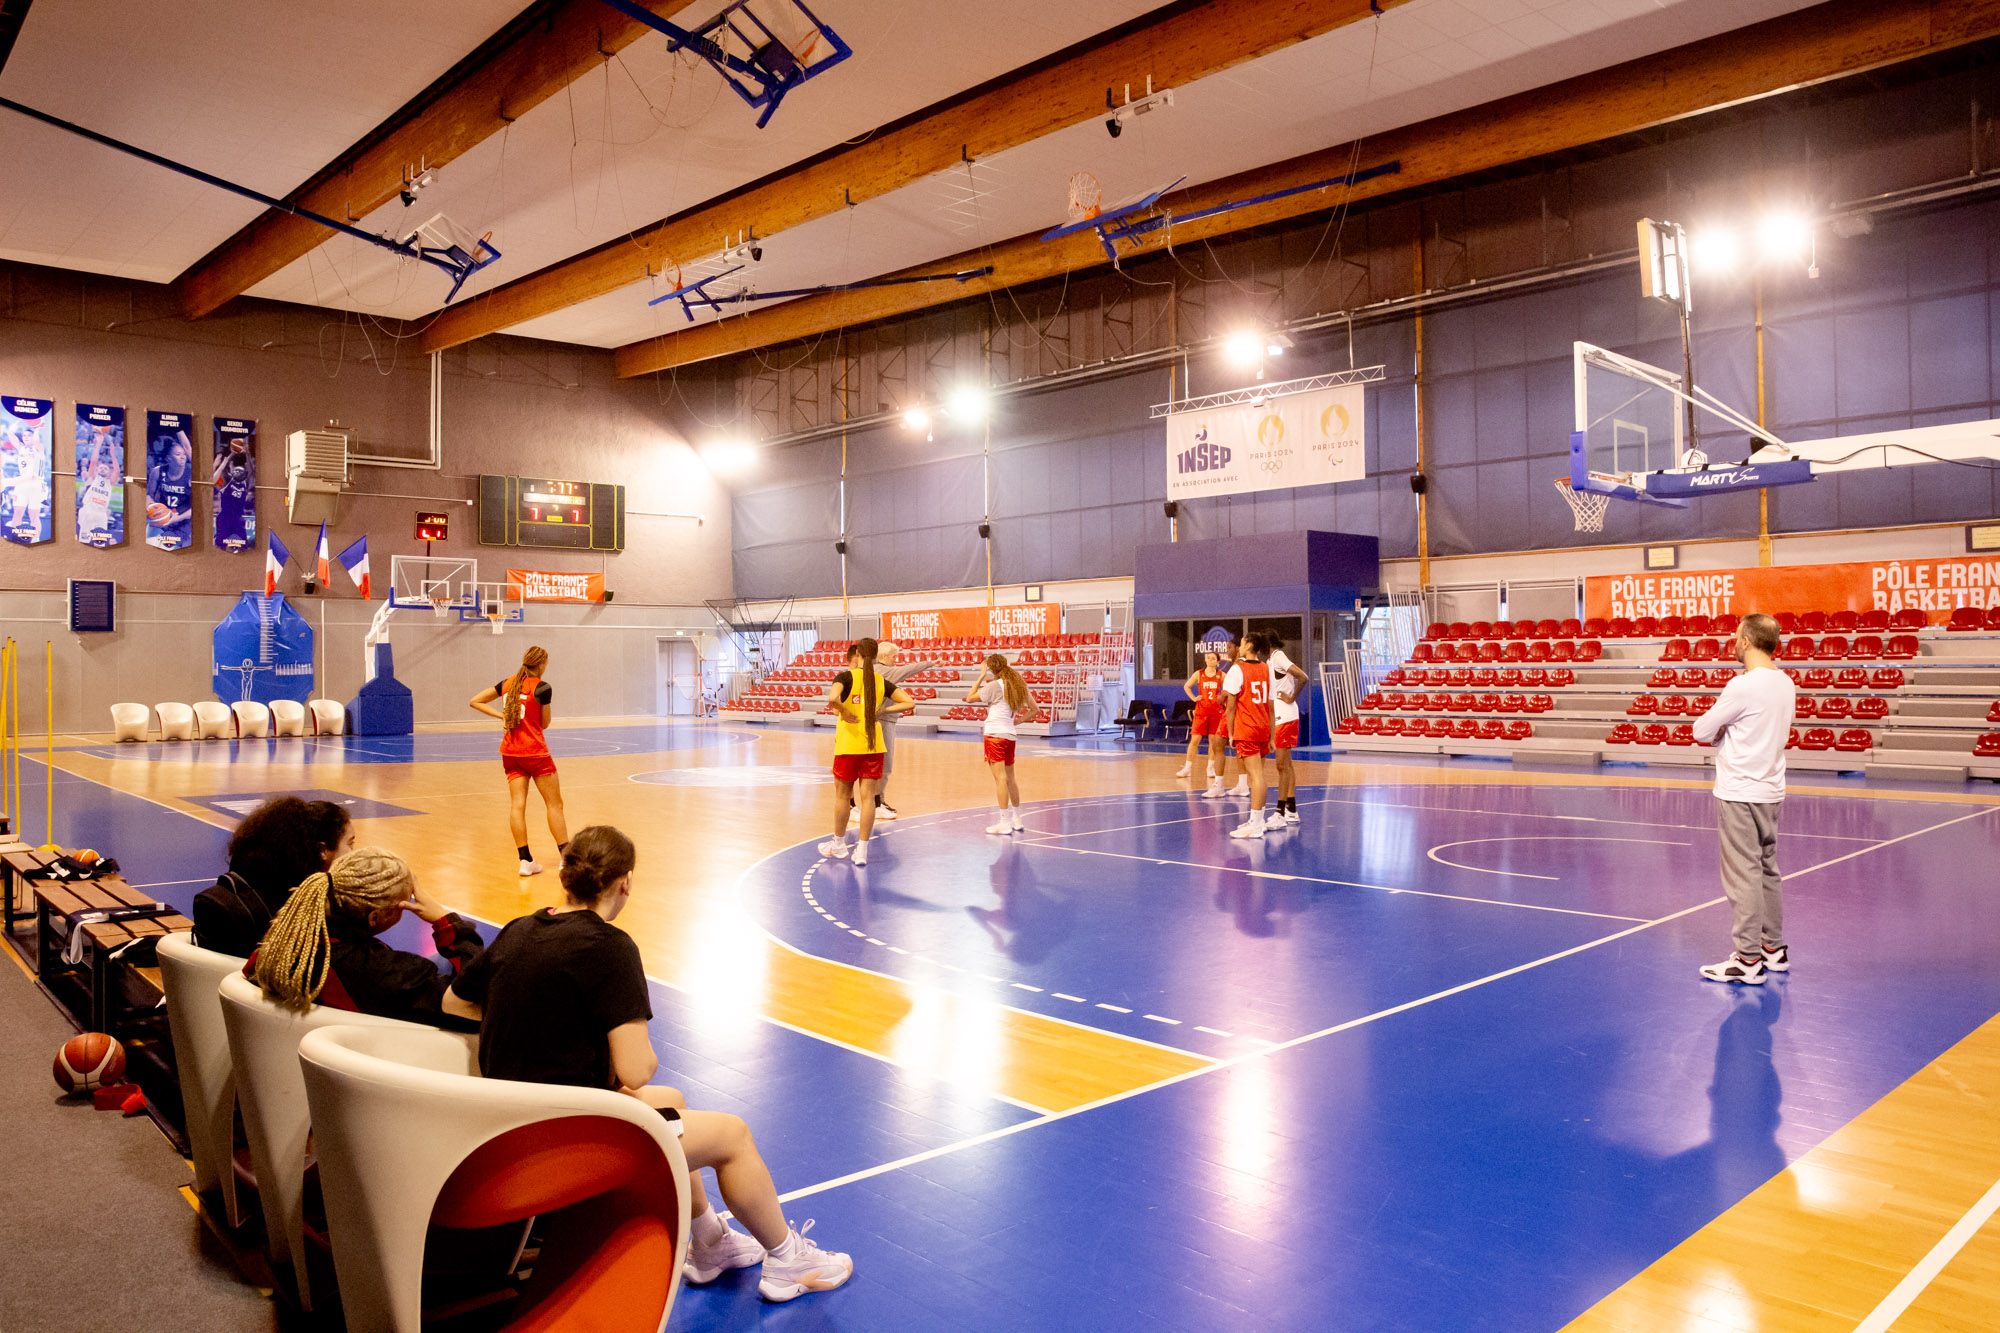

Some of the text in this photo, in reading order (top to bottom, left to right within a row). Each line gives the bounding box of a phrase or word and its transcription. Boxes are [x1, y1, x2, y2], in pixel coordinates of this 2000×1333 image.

[89, 413, 111, 421] PARKER
[1312, 440, 1359, 451] PARIS 2024
[1177, 443, 1231, 474] INSEP
[1250, 448, 1294, 460] PARIS 2024
[1182, 477, 1221, 487] ASSOCIATION
[1690, 472, 1737, 487] MARTY
[162, 483, 185, 494] FRANCE
[167, 496, 179, 508] 12
[525, 571, 589, 587] PÔLE FRANCE
[1872, 561, 1930, 590] PÔLE
[526, 584, 589, 600] BASKETBALL
[1611, 574, 1735, 600] PÔLE FRANCE
[989, 606, 1047, 624] PÔLE FRANCE
[1611, 597, 1730, 622] BASKETBALL
[891, 612, 939, 628] PÔLE FRANCE
[1195, 640, 1228, 653] PÔLE FRA
[1207, 691, 1213, 699] 2
[1251, 681, 1268, 704] 51
